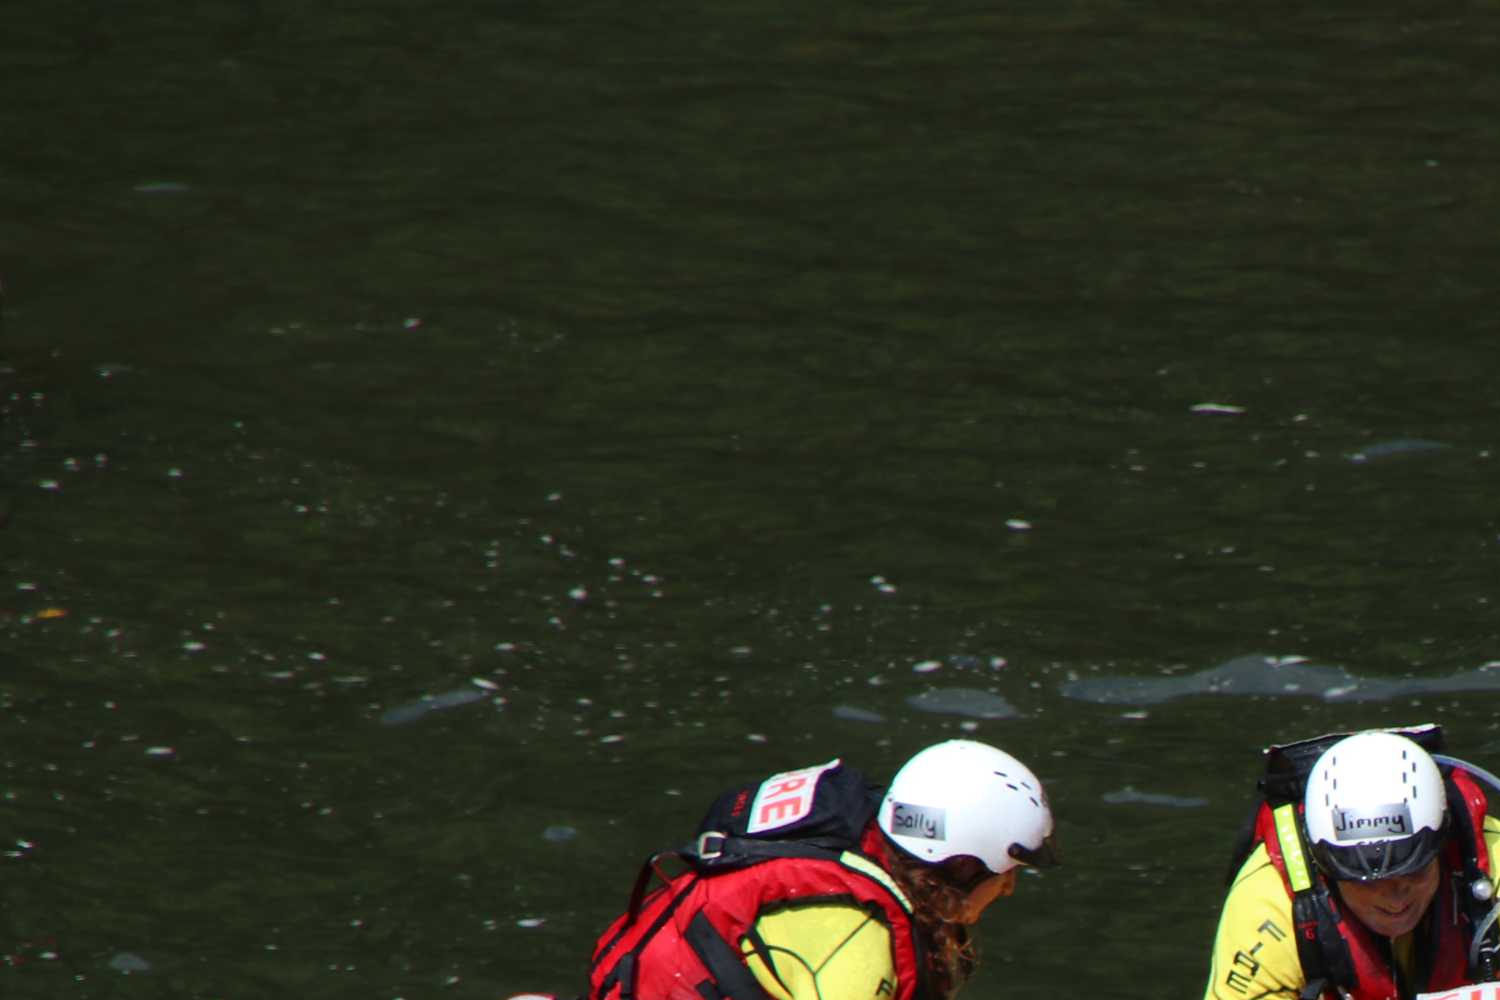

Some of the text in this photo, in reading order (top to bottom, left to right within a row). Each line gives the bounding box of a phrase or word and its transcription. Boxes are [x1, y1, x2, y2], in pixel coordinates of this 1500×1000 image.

[893, 805, 938, 839] Sally
[1336, 812, 1406, 833] Jimmy
[1226, 919, 1287, 995] FIRE
